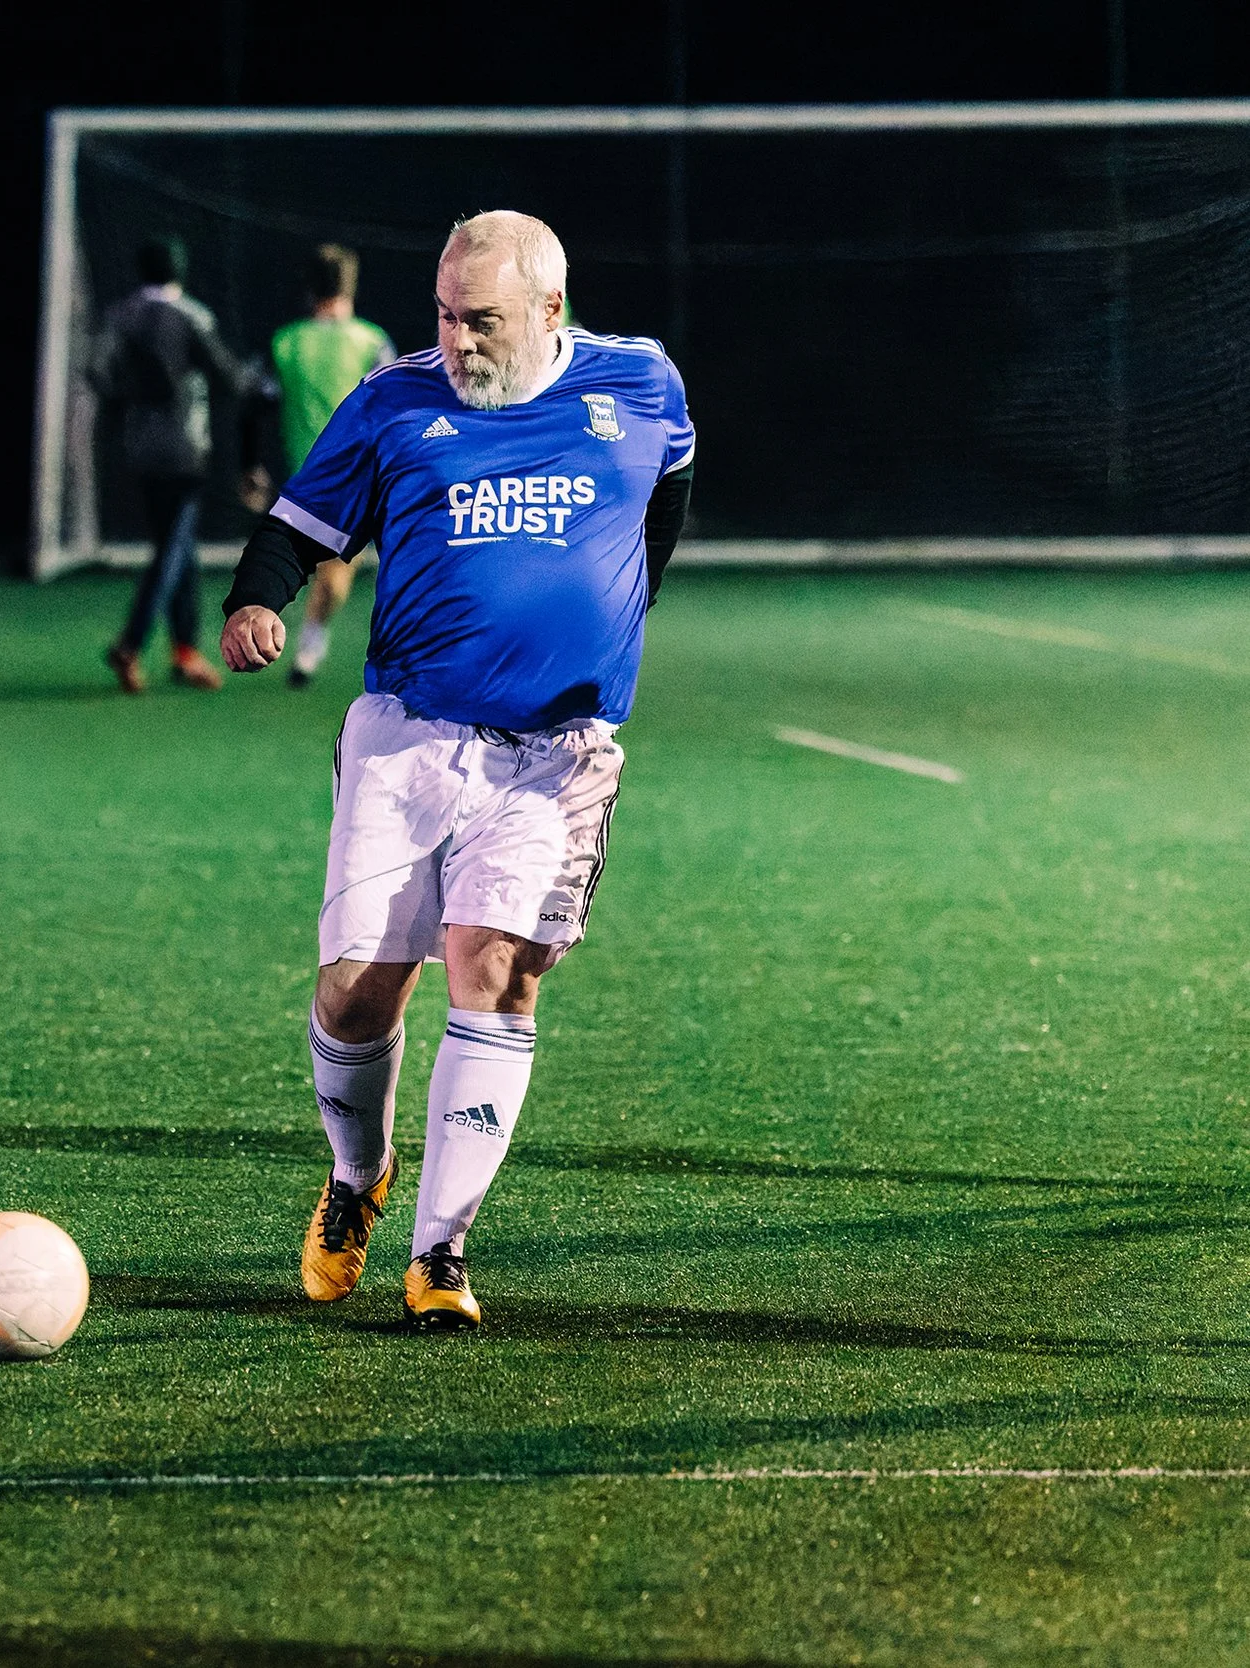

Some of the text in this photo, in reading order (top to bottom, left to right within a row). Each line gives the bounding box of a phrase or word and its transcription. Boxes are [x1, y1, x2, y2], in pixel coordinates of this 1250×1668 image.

[422, 429, 459, 438] adidas
[448, 476, 595, 508] CARERS
[449, 507, 571, 534] TRUST
[443, 1113, 505, 1138] adidas
